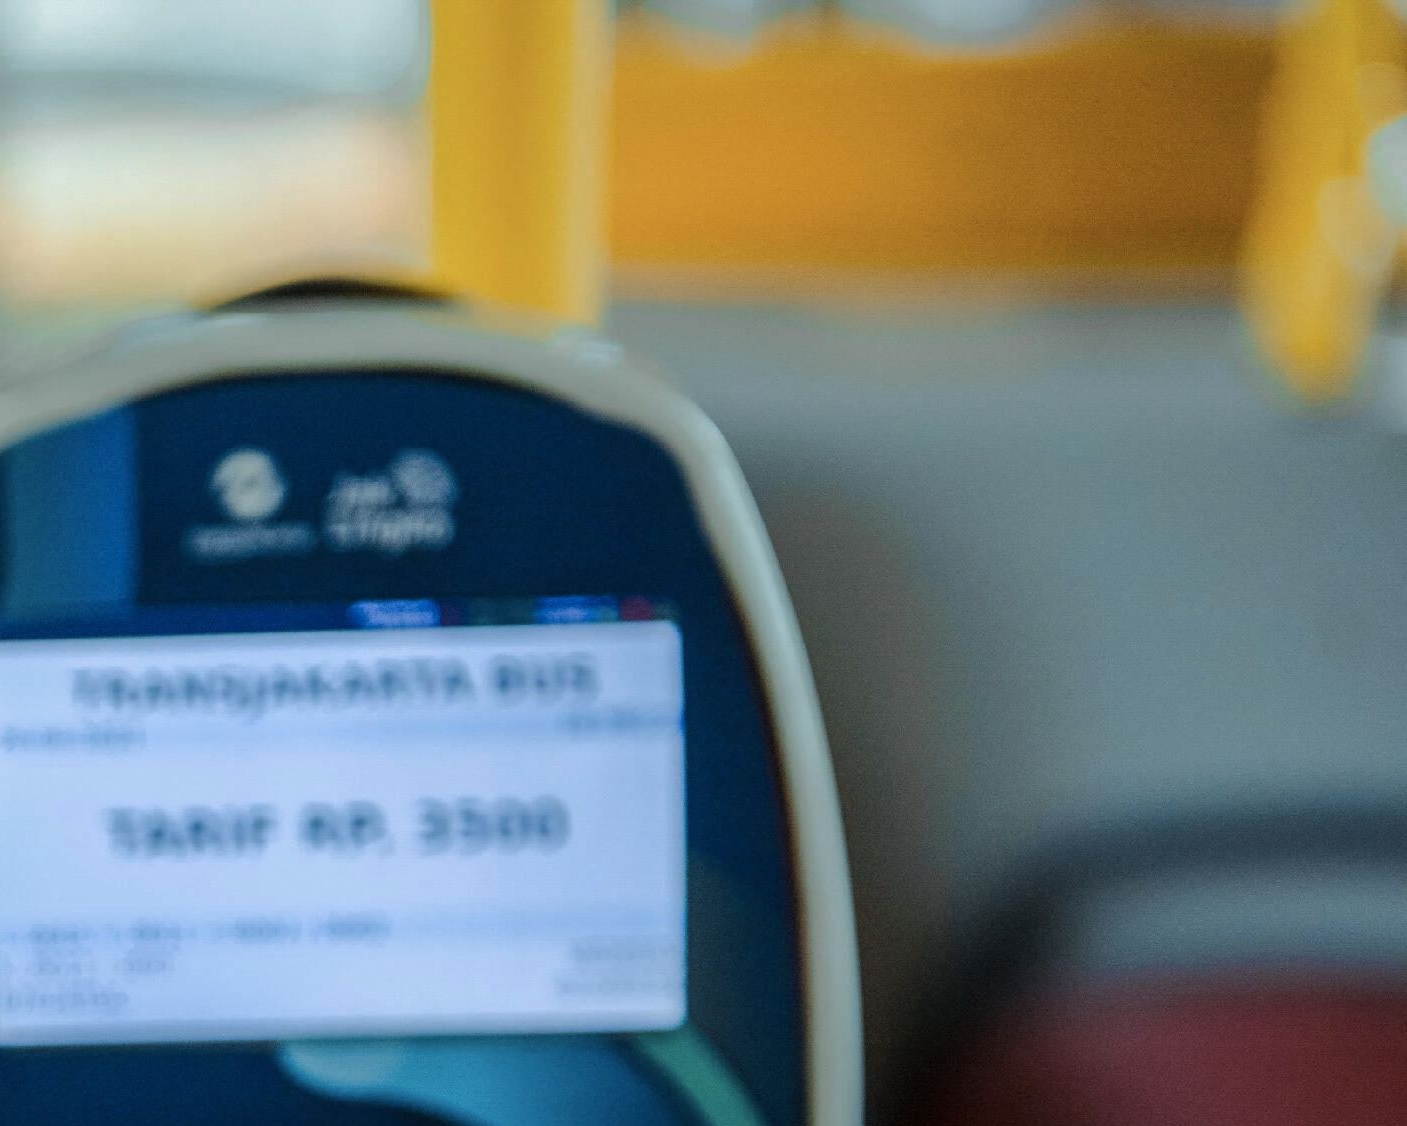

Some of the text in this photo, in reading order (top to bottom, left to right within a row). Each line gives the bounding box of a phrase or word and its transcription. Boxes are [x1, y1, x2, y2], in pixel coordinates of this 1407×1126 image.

[71, 652, 603, 722] TRANSJAKARTA BUS
[100, 803, 278, 860] TARIF
[413, 794, 573, 857] 3500
